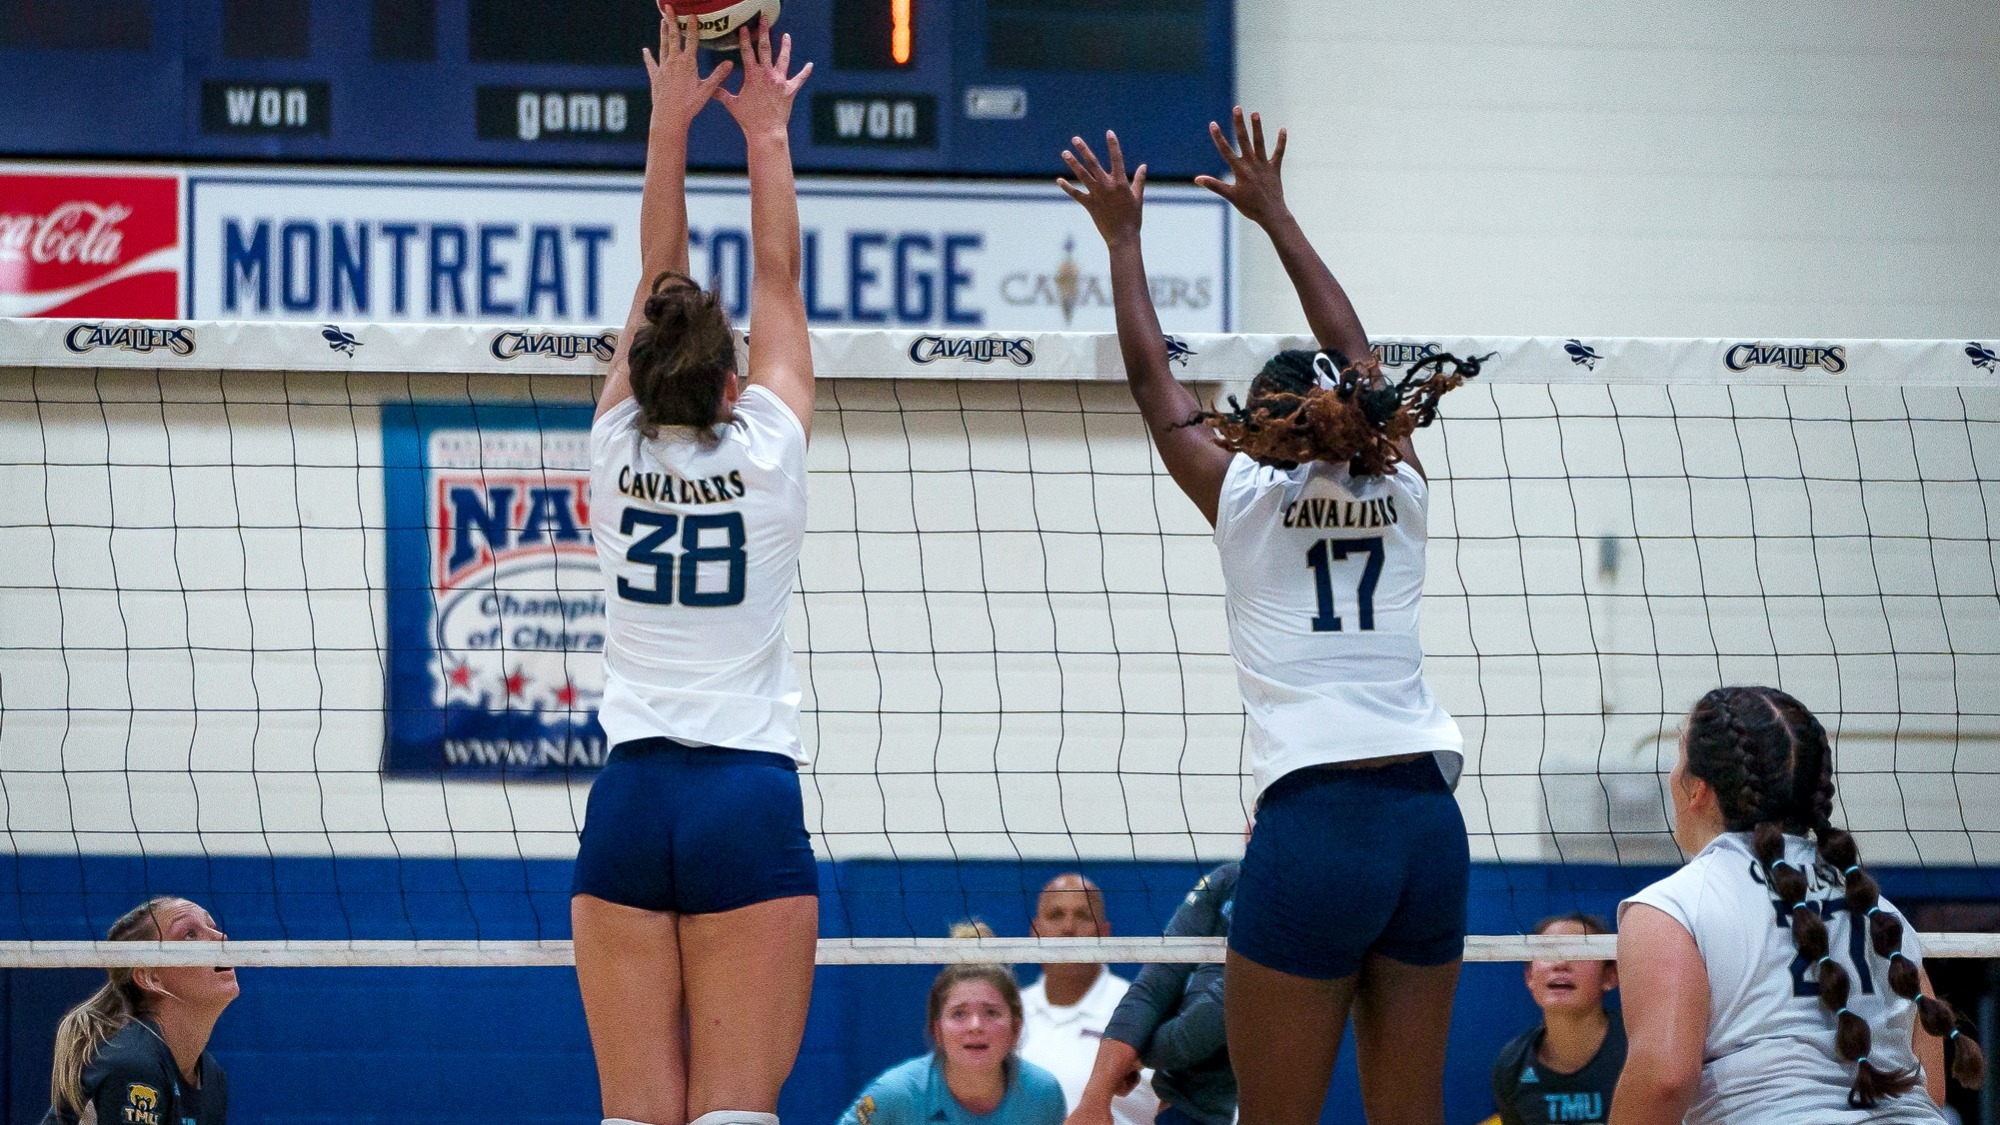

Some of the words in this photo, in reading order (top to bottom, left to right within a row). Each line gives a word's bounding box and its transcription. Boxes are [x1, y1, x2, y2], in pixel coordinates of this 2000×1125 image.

[679, 15, 729, 32] Badn
[226, 88, 308, 126] won
[517, 93, 628, 140] game
[834, 101, 917, 138] won
[224, 216, 612, 319] MONTREAT
[689, 226, 984, 324] OLEGE
[65, 323, 196, 357] CAVALIERS
[490, 331, 617, 363] CAVALIERS
[909, 335, 1035, 366] CAVALIERS
[1724, 342, 1846, 374] CAVALIERS
[618, 464, 747, 504] CAVALIERS
[1283, 495, 1399, 528] CAVALIERS
[450, 487, 595, 573] NA
[617, 506, 747, 607] 38
[1306, 536, 1386, 632] 17
[468, 627, 500, 648] of
[124, 1107, 159, 1125] TMU
[1544, 1092, 1602, 1121] TMU
